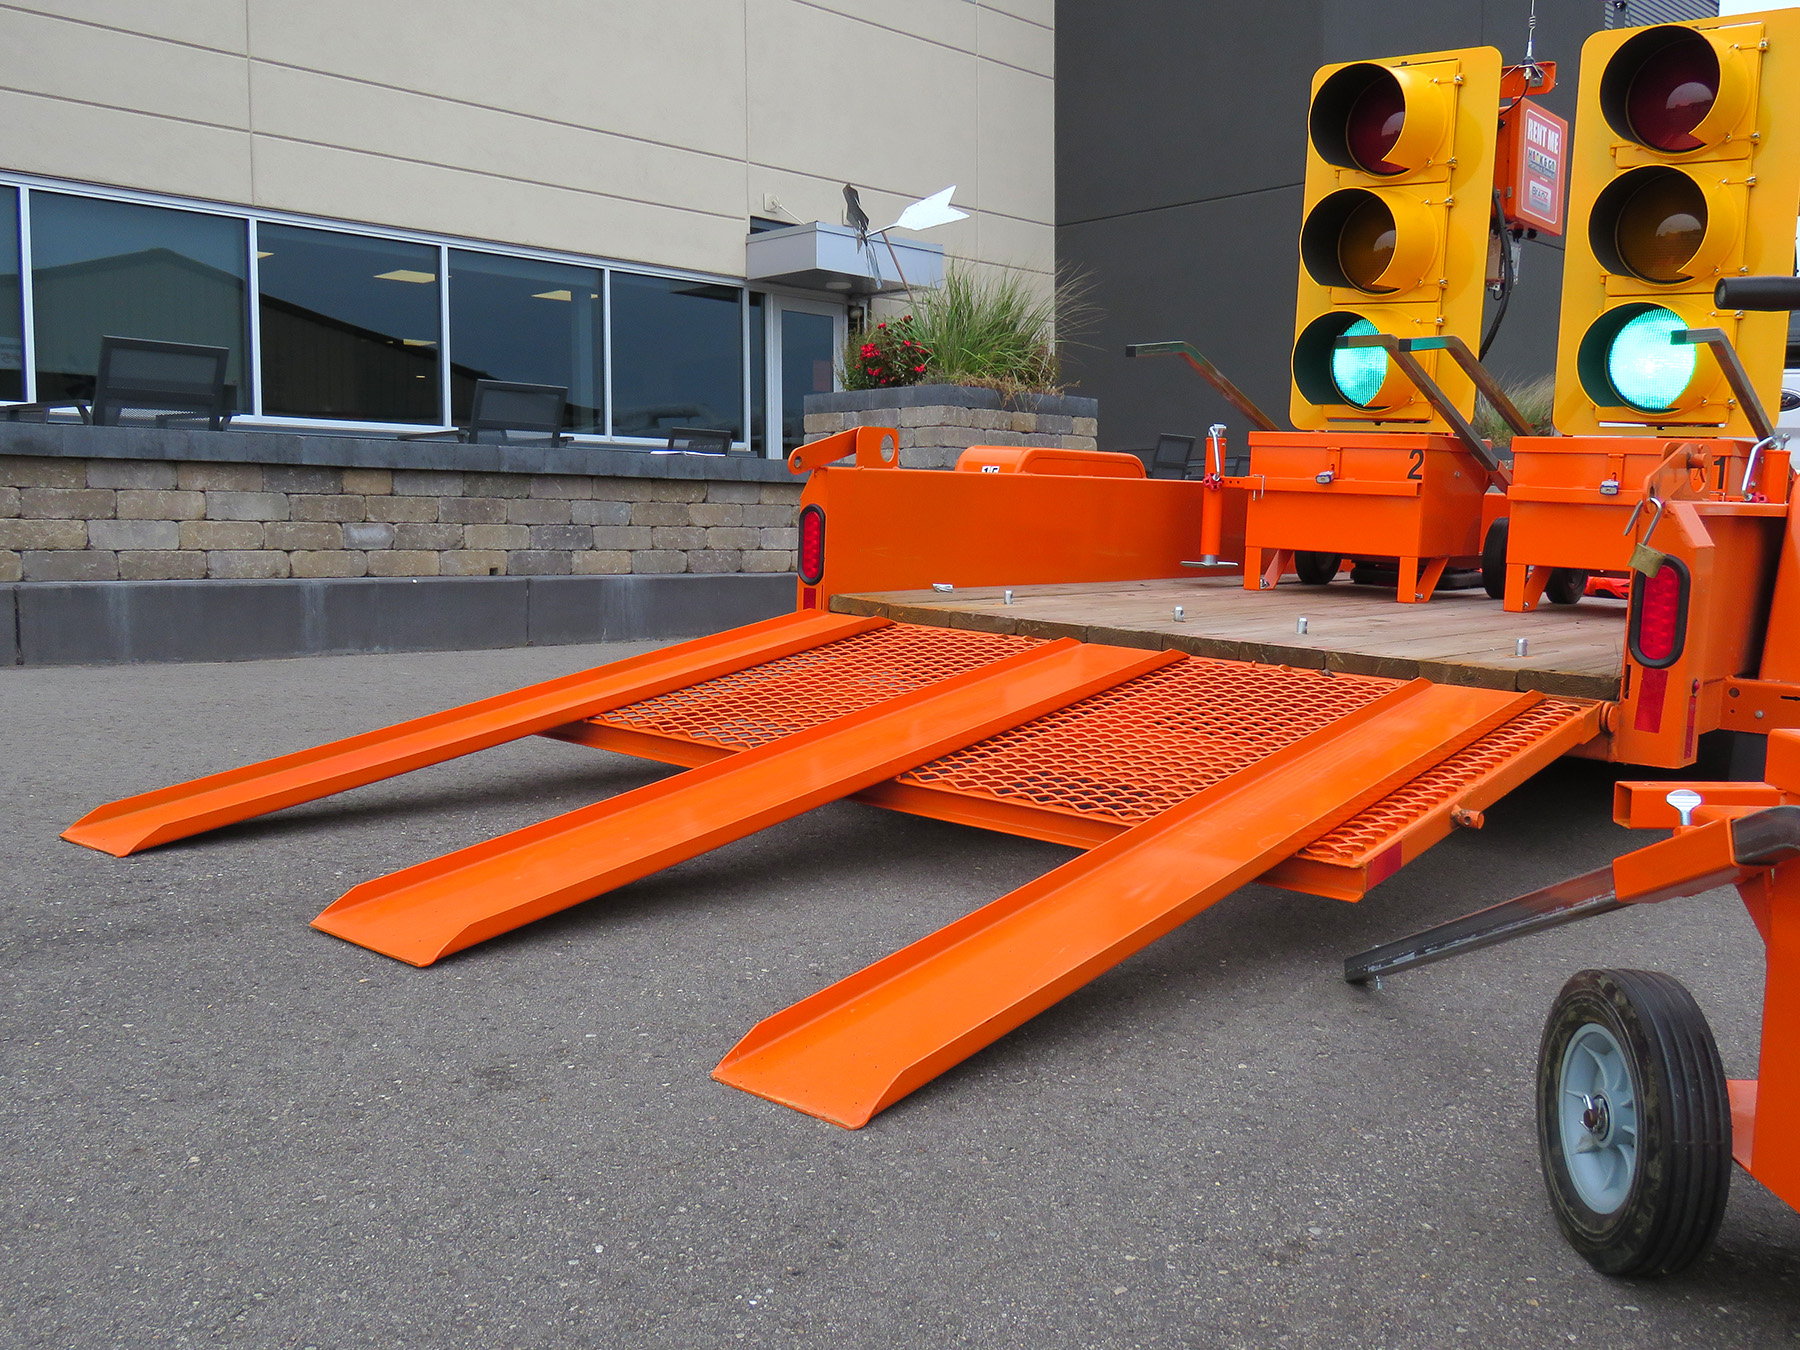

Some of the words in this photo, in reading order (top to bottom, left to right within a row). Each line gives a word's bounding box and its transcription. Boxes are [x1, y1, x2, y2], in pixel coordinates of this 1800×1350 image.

[1528, 118, 1547, 147] RENT
[1547, 129, 1559, 154] ME
[1407, 449, 1424, 480] 2
[1713, 456, 1725, 489] 1
